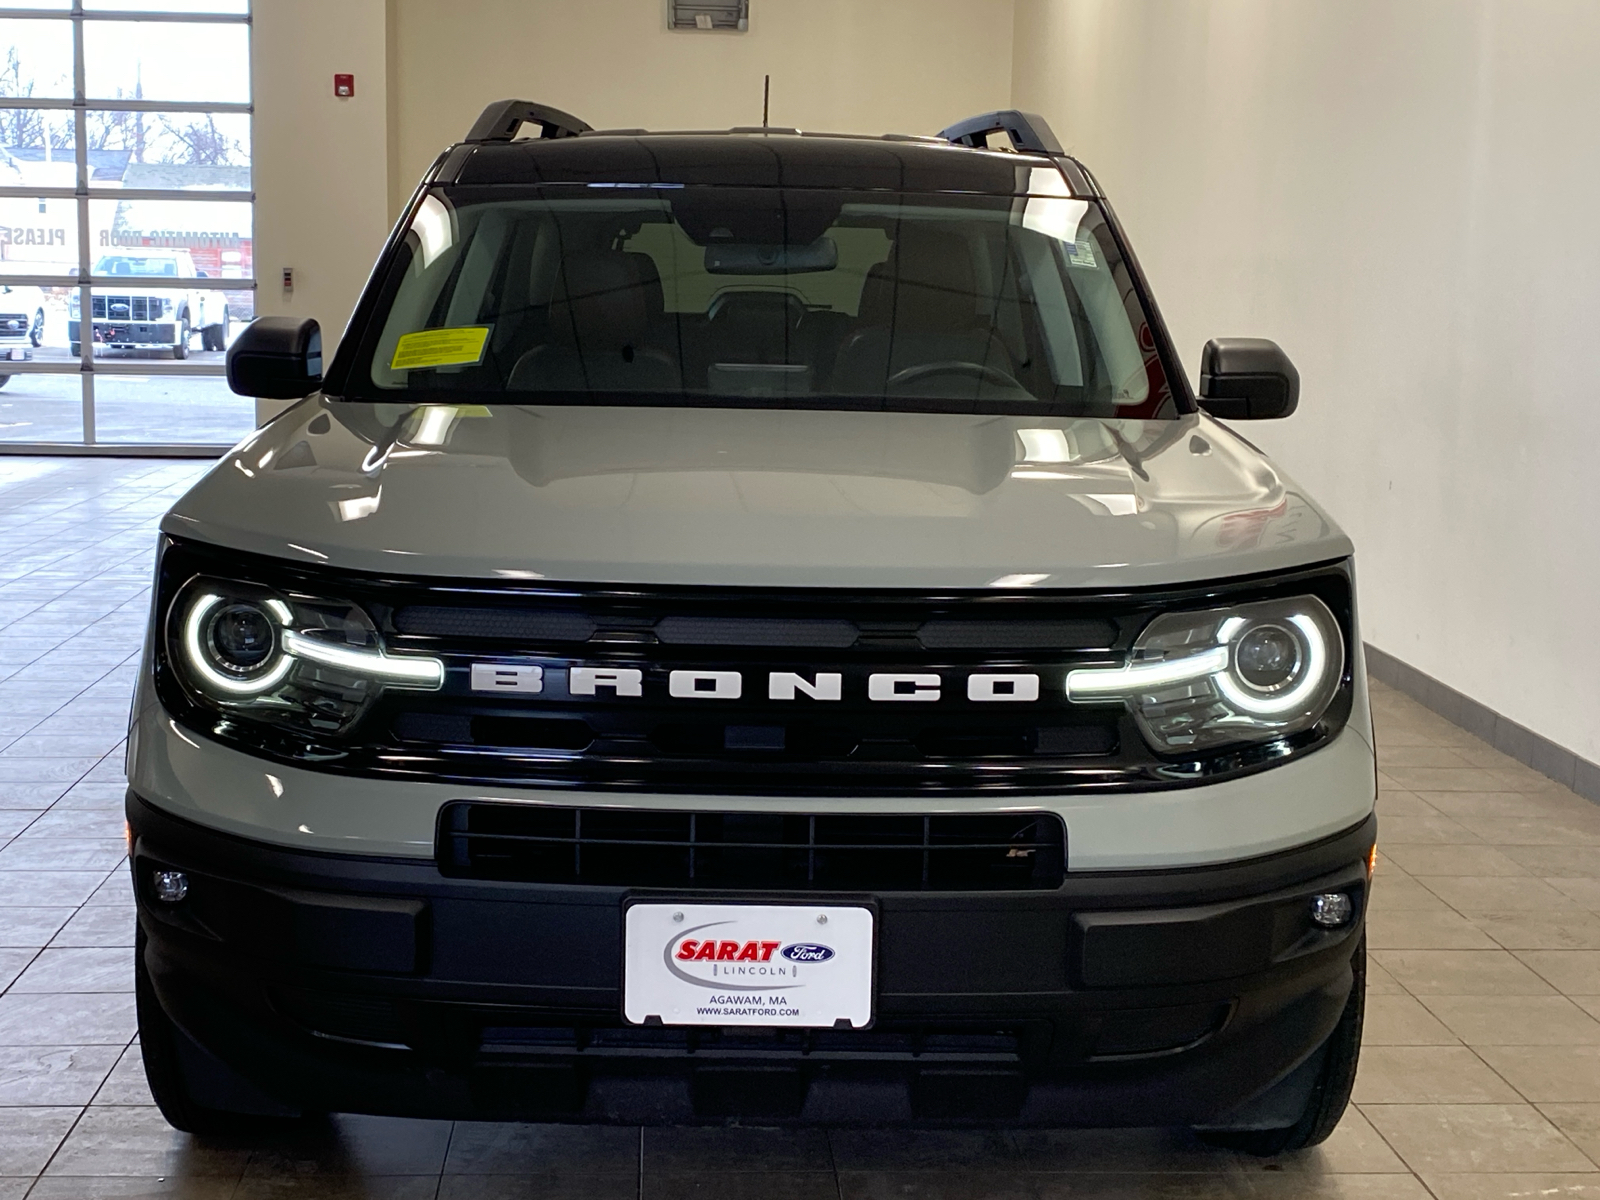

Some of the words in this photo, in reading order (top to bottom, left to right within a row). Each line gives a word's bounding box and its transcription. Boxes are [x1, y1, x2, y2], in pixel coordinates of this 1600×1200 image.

[470, 662, 1040, 702] BRONCO
[675, 939, 781, 963] SARAT
[789, 946, 825, 961] Ford
[723, 966, 786, 976] LINCOLN
[709, 995, 766, 1006] AGAWAM,
[769, 996, 787, 1006] MA
[697, 1007, 799, 1016] WWW.SARATFORD.COM
